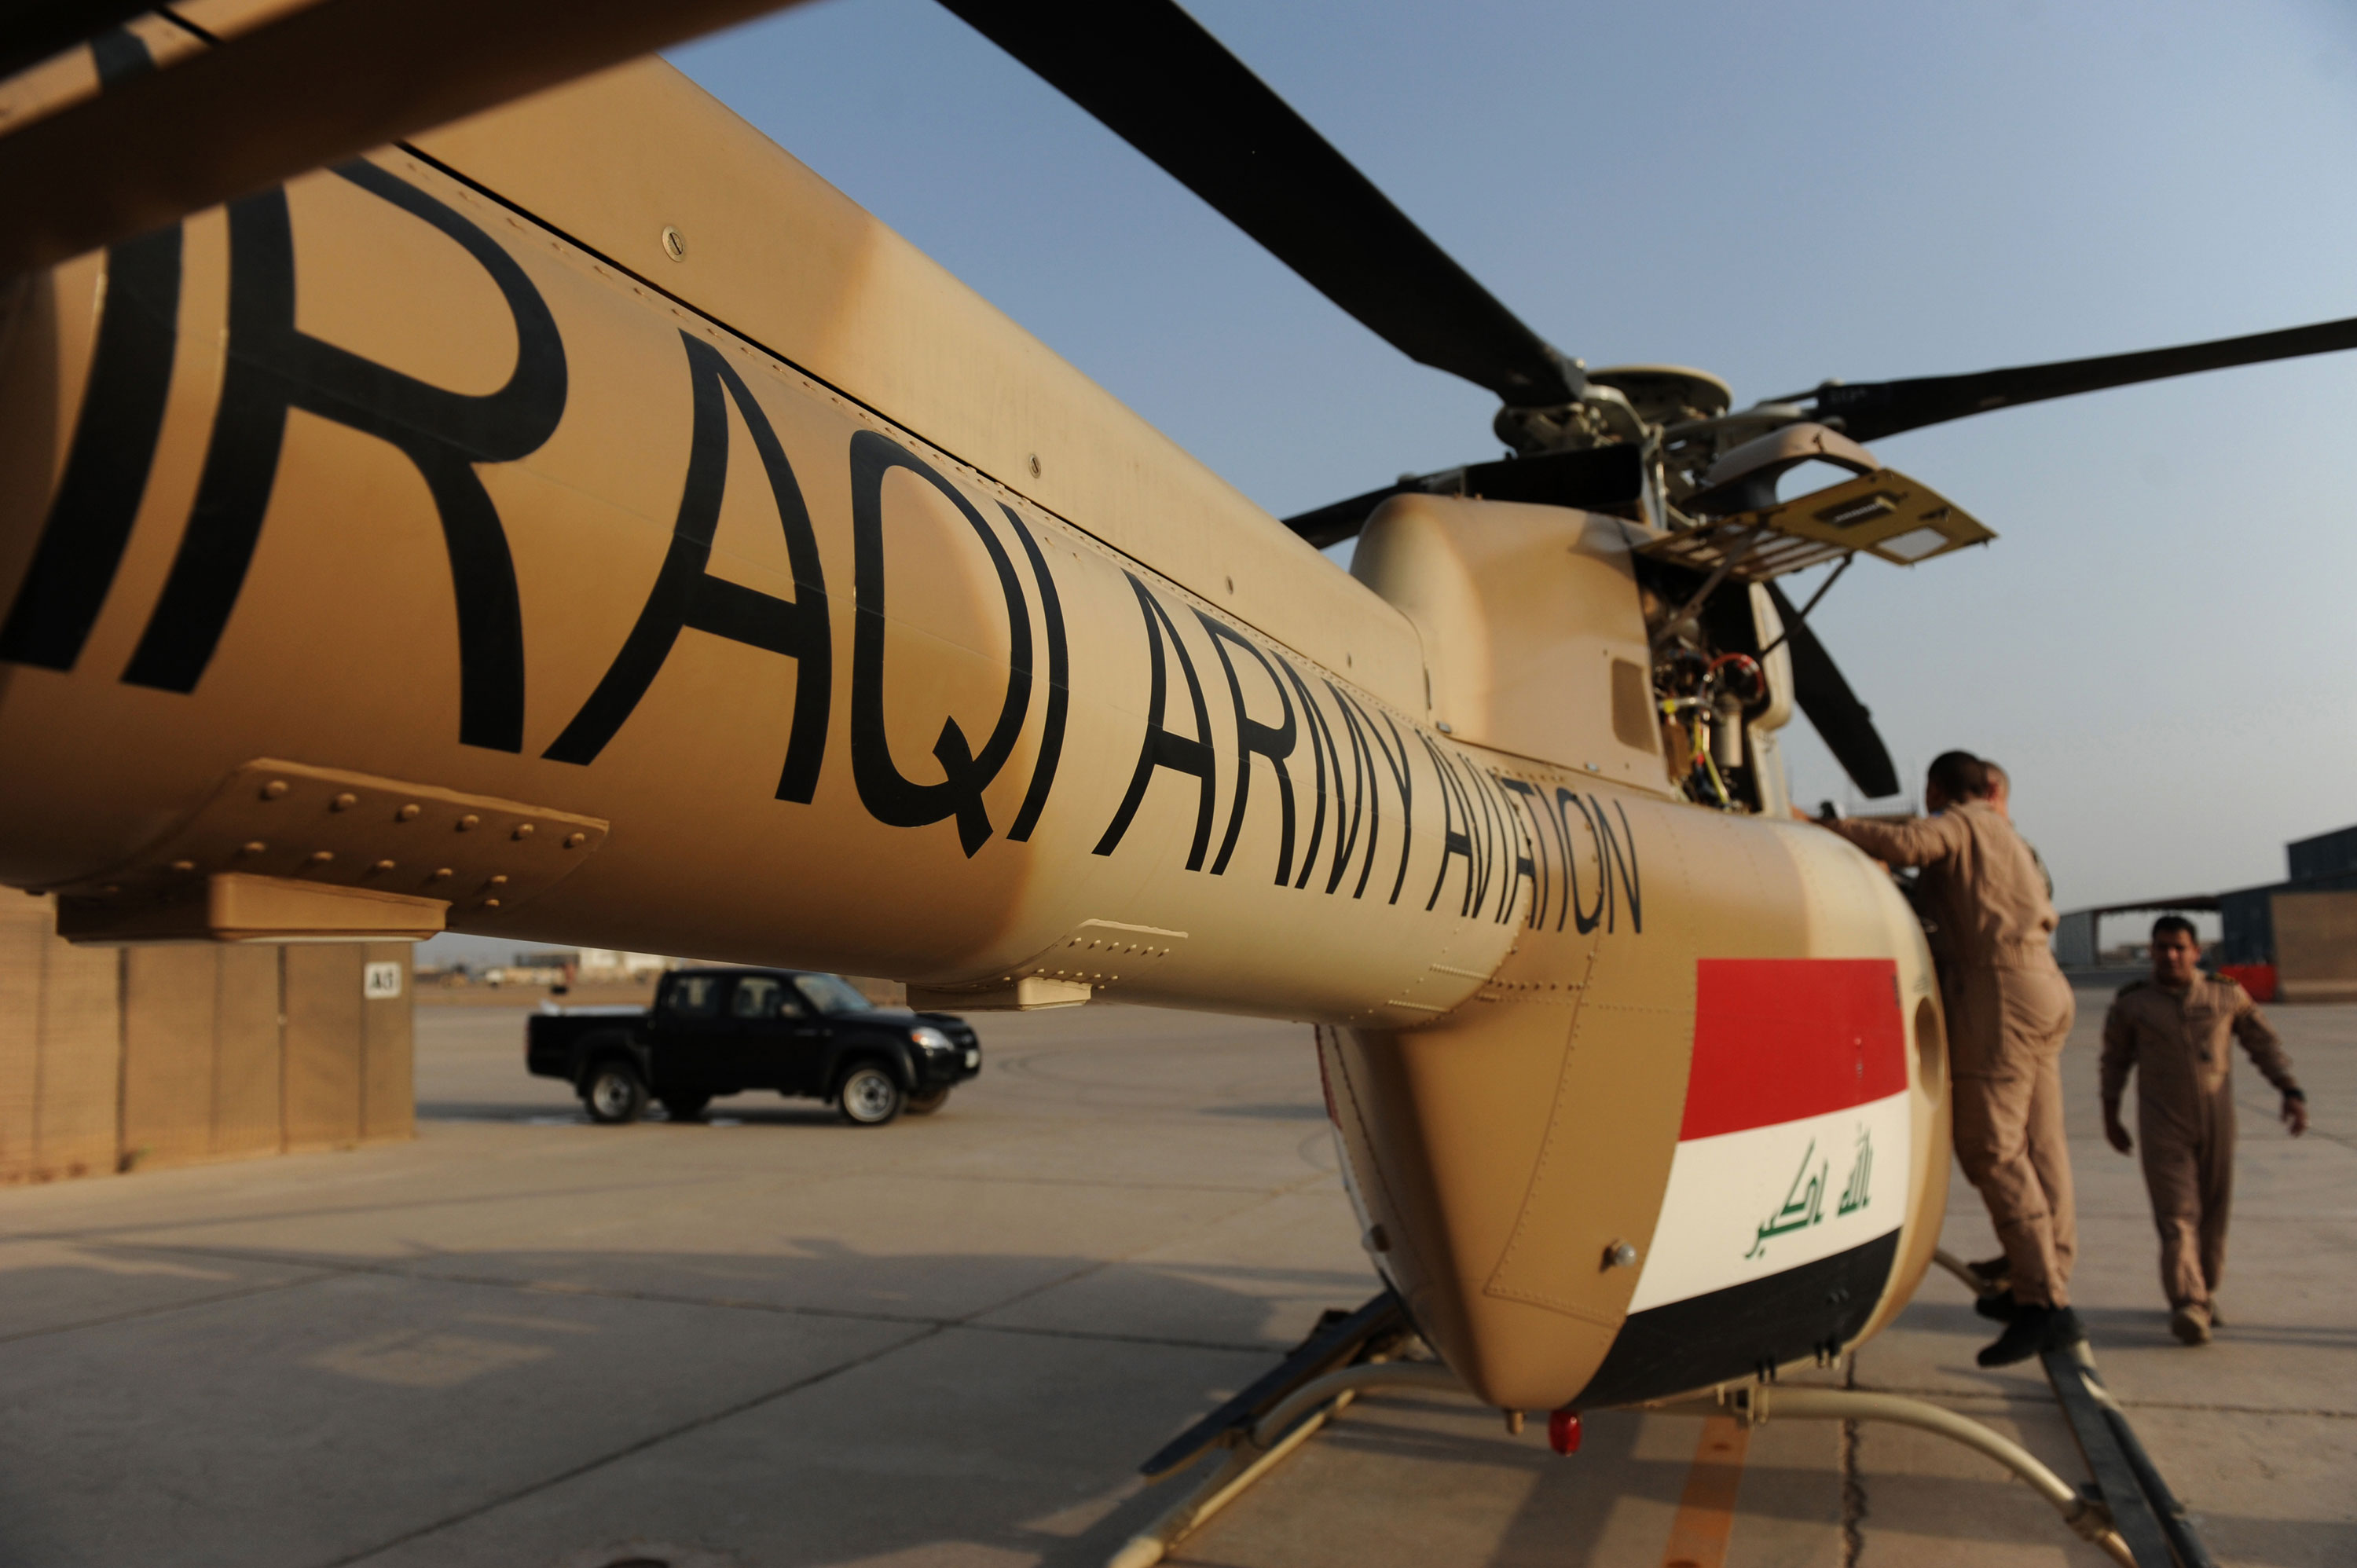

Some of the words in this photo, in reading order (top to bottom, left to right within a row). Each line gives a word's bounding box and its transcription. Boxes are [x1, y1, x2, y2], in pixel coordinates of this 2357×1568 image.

[0, 22, 1069, 859] IRAQI
[1091, 568, 1412, 905] ARMY
[1415, 728, 1641, 935] AVIATION
